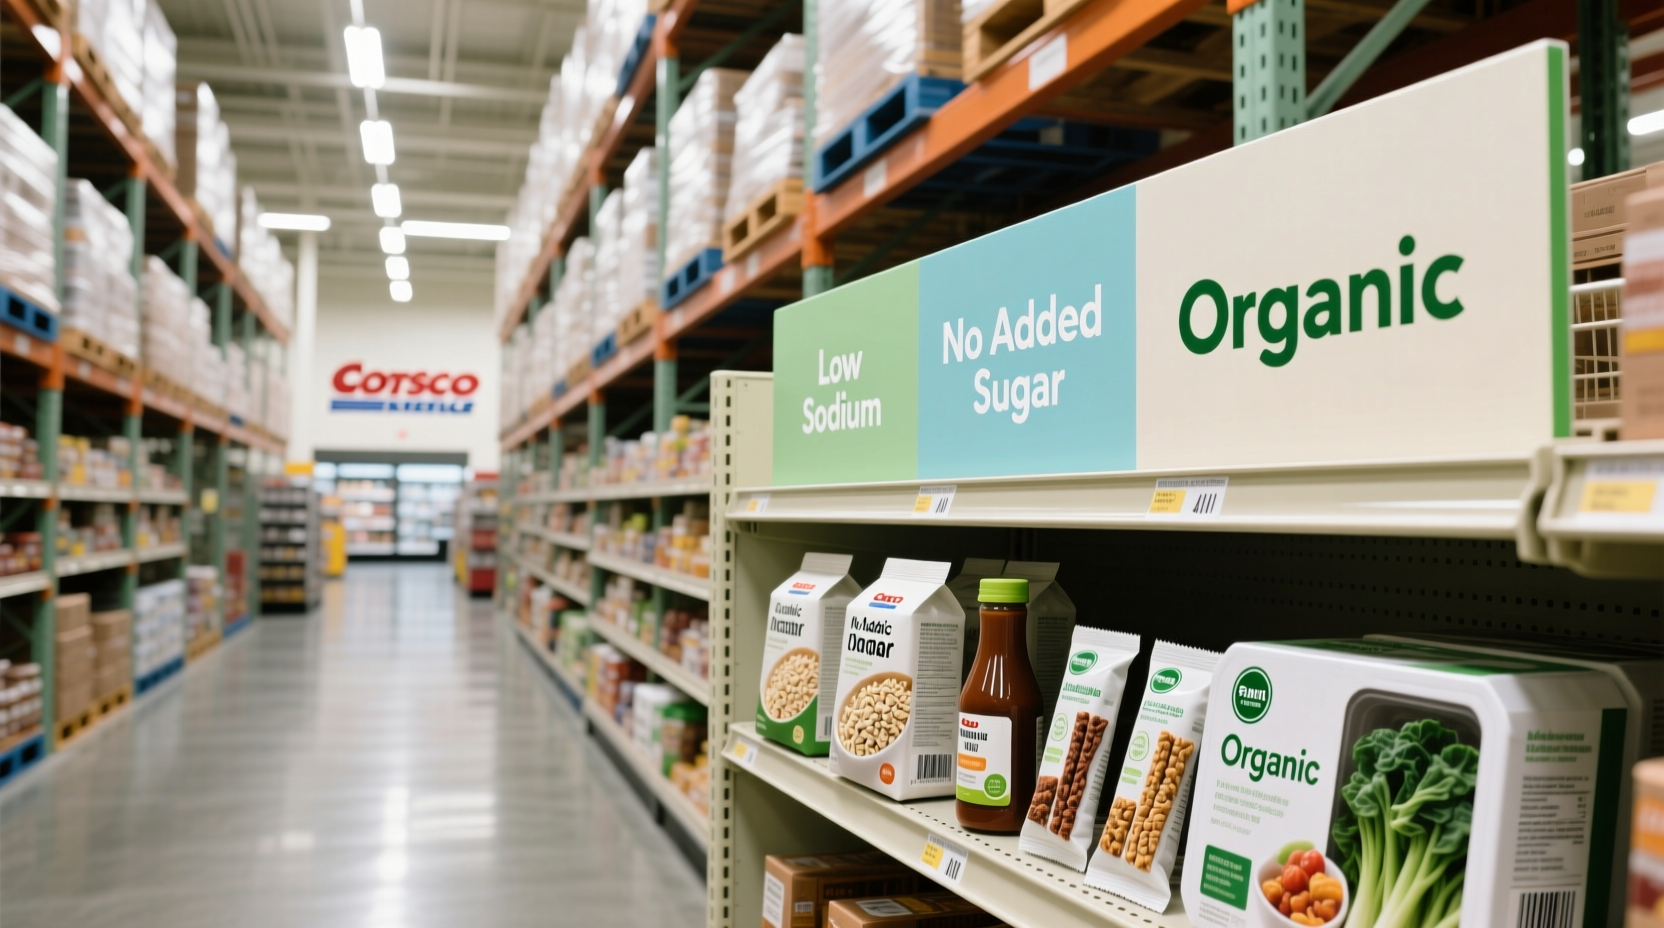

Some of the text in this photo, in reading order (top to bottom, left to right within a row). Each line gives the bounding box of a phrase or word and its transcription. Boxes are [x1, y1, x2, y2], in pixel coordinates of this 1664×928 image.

[943, 283, 1103, 363] No Added
[1179, 234, 1465, 367] Organic
[817, 350, 862, 385] Low
[802, 391, 882, 434] Sodium
[973, 367, 1066, 424] Sugar
[1221, 733, 1320, 785] Organic
